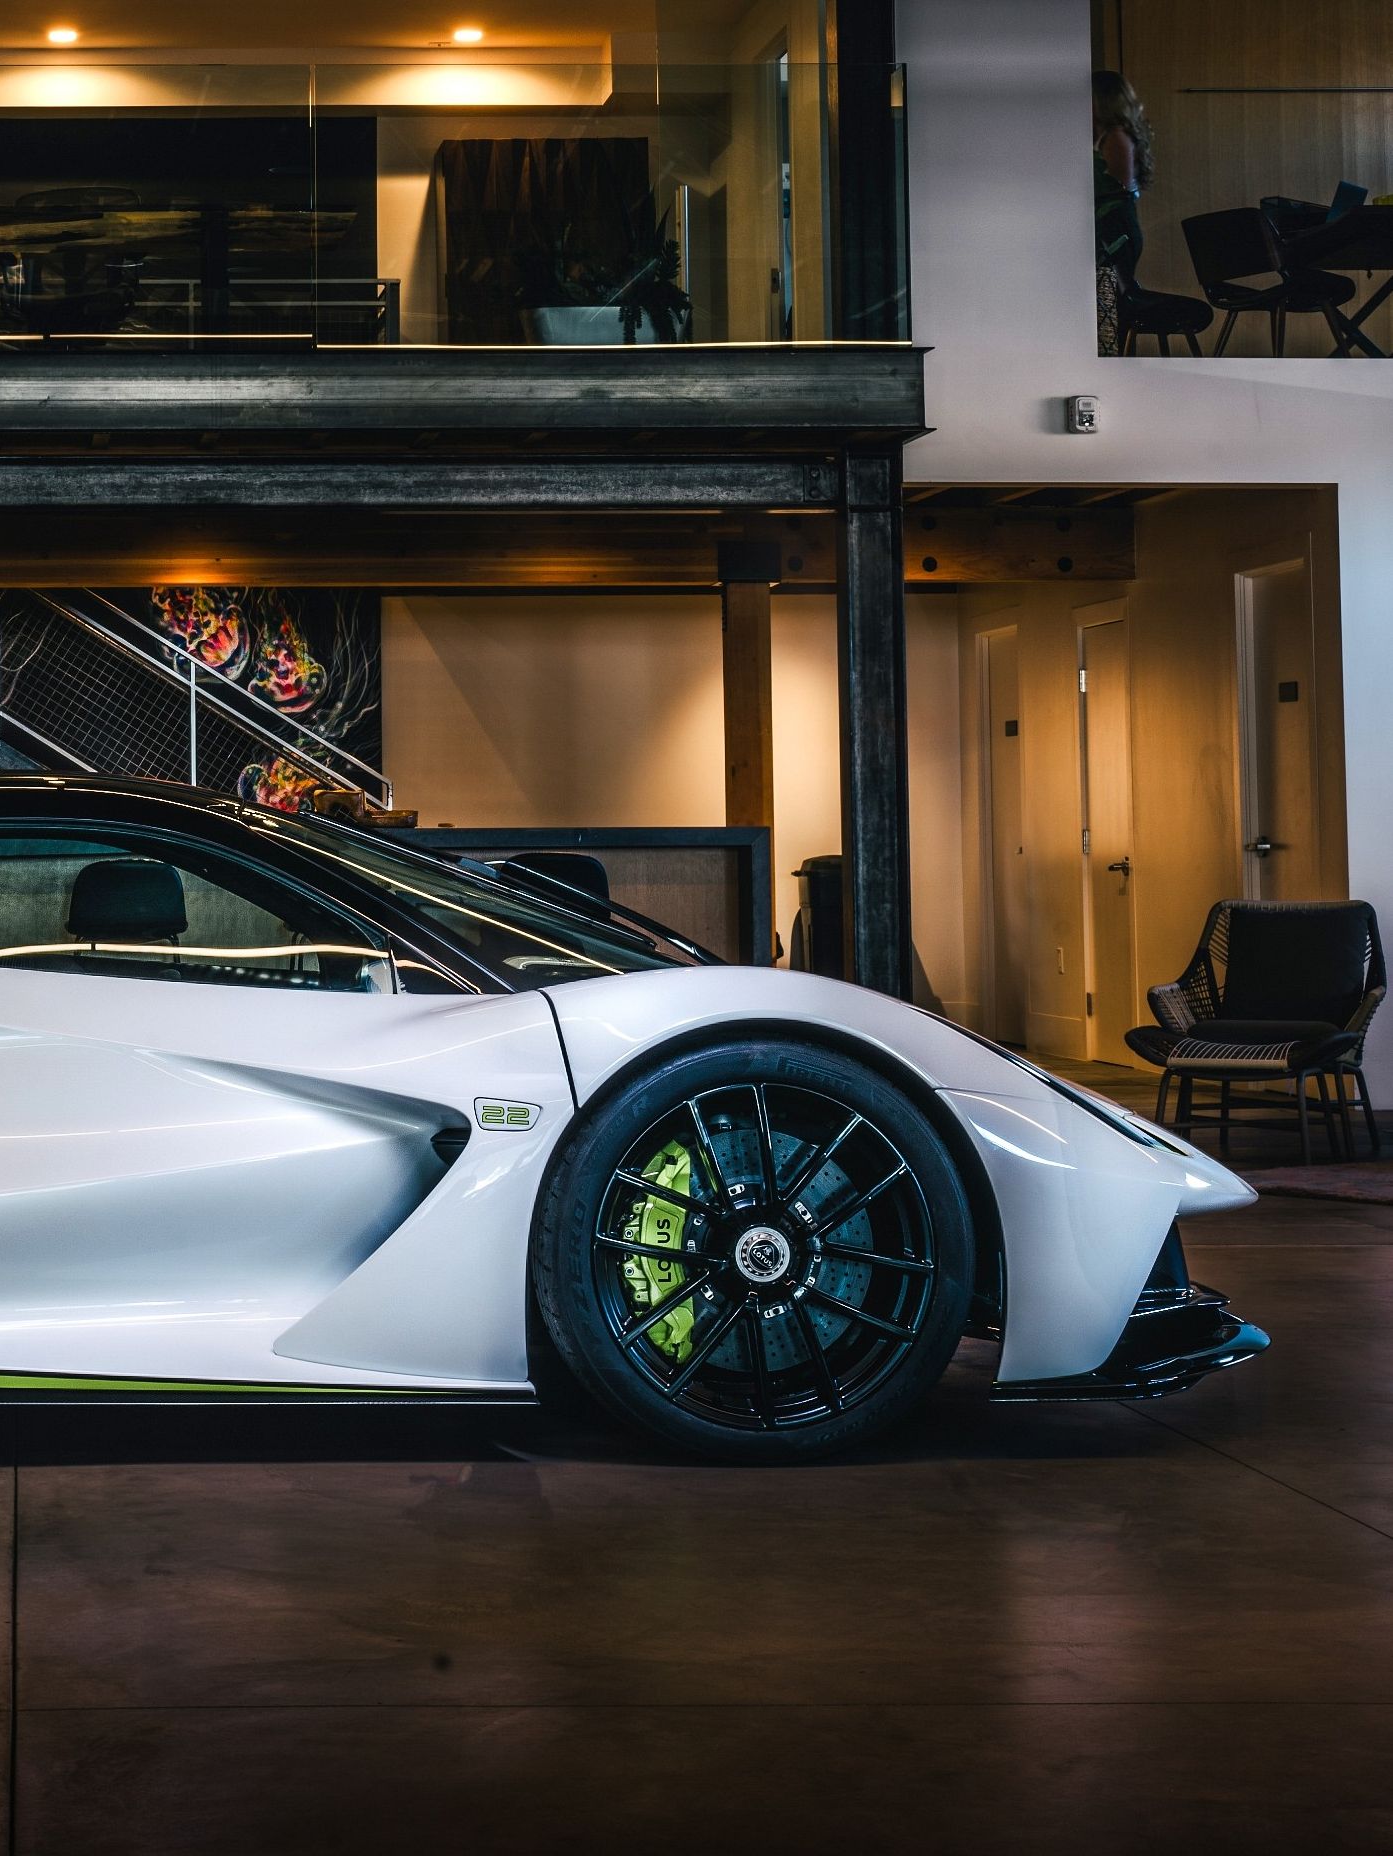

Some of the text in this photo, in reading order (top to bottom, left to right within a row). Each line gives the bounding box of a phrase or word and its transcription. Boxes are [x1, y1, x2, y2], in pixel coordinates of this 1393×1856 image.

[481, 1105, 530, 1126] 22
[656, 1218, 672, 1283] LOUS
[752, 1248, 773, 1267] LOTUS
